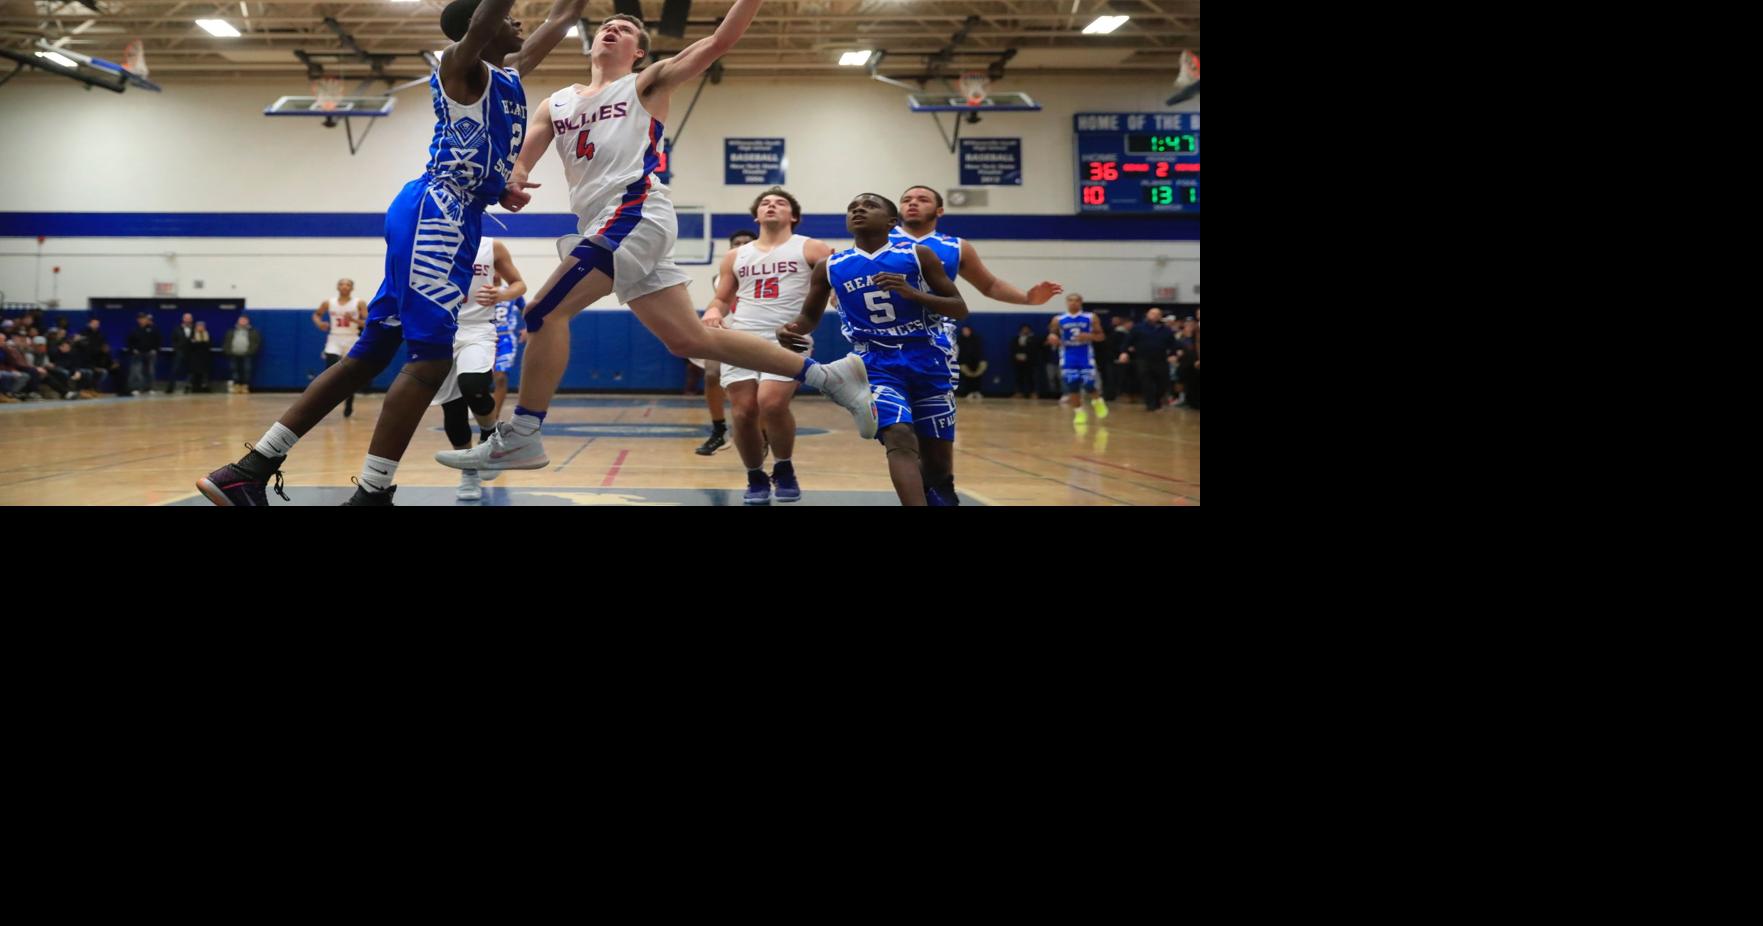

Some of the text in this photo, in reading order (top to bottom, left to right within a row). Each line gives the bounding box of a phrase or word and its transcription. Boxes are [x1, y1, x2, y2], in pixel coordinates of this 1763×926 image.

[1078, 115, 1118, 130] HOME
[1127, 115, 1146, 130] OF
[1154, 115, 1181, 130] THE
[576, 129, 595, 161] 4
[1151, 134, 1195, 152] 1:47
[730, 153, 778, 162] BASEBALL
[965, 153, 1015, 162] BASEBALL
[1089, 161, 1118, 181] 36
[1156, 161, 1169, 178] 2
[1083, 185, 1105, 205] 10
[1151, 185, 1173, 205] 13
[739, 261, 798, 277] BILLIES
[754, 277, 779, 299] 15
[863, 290, 896, 324] 5
